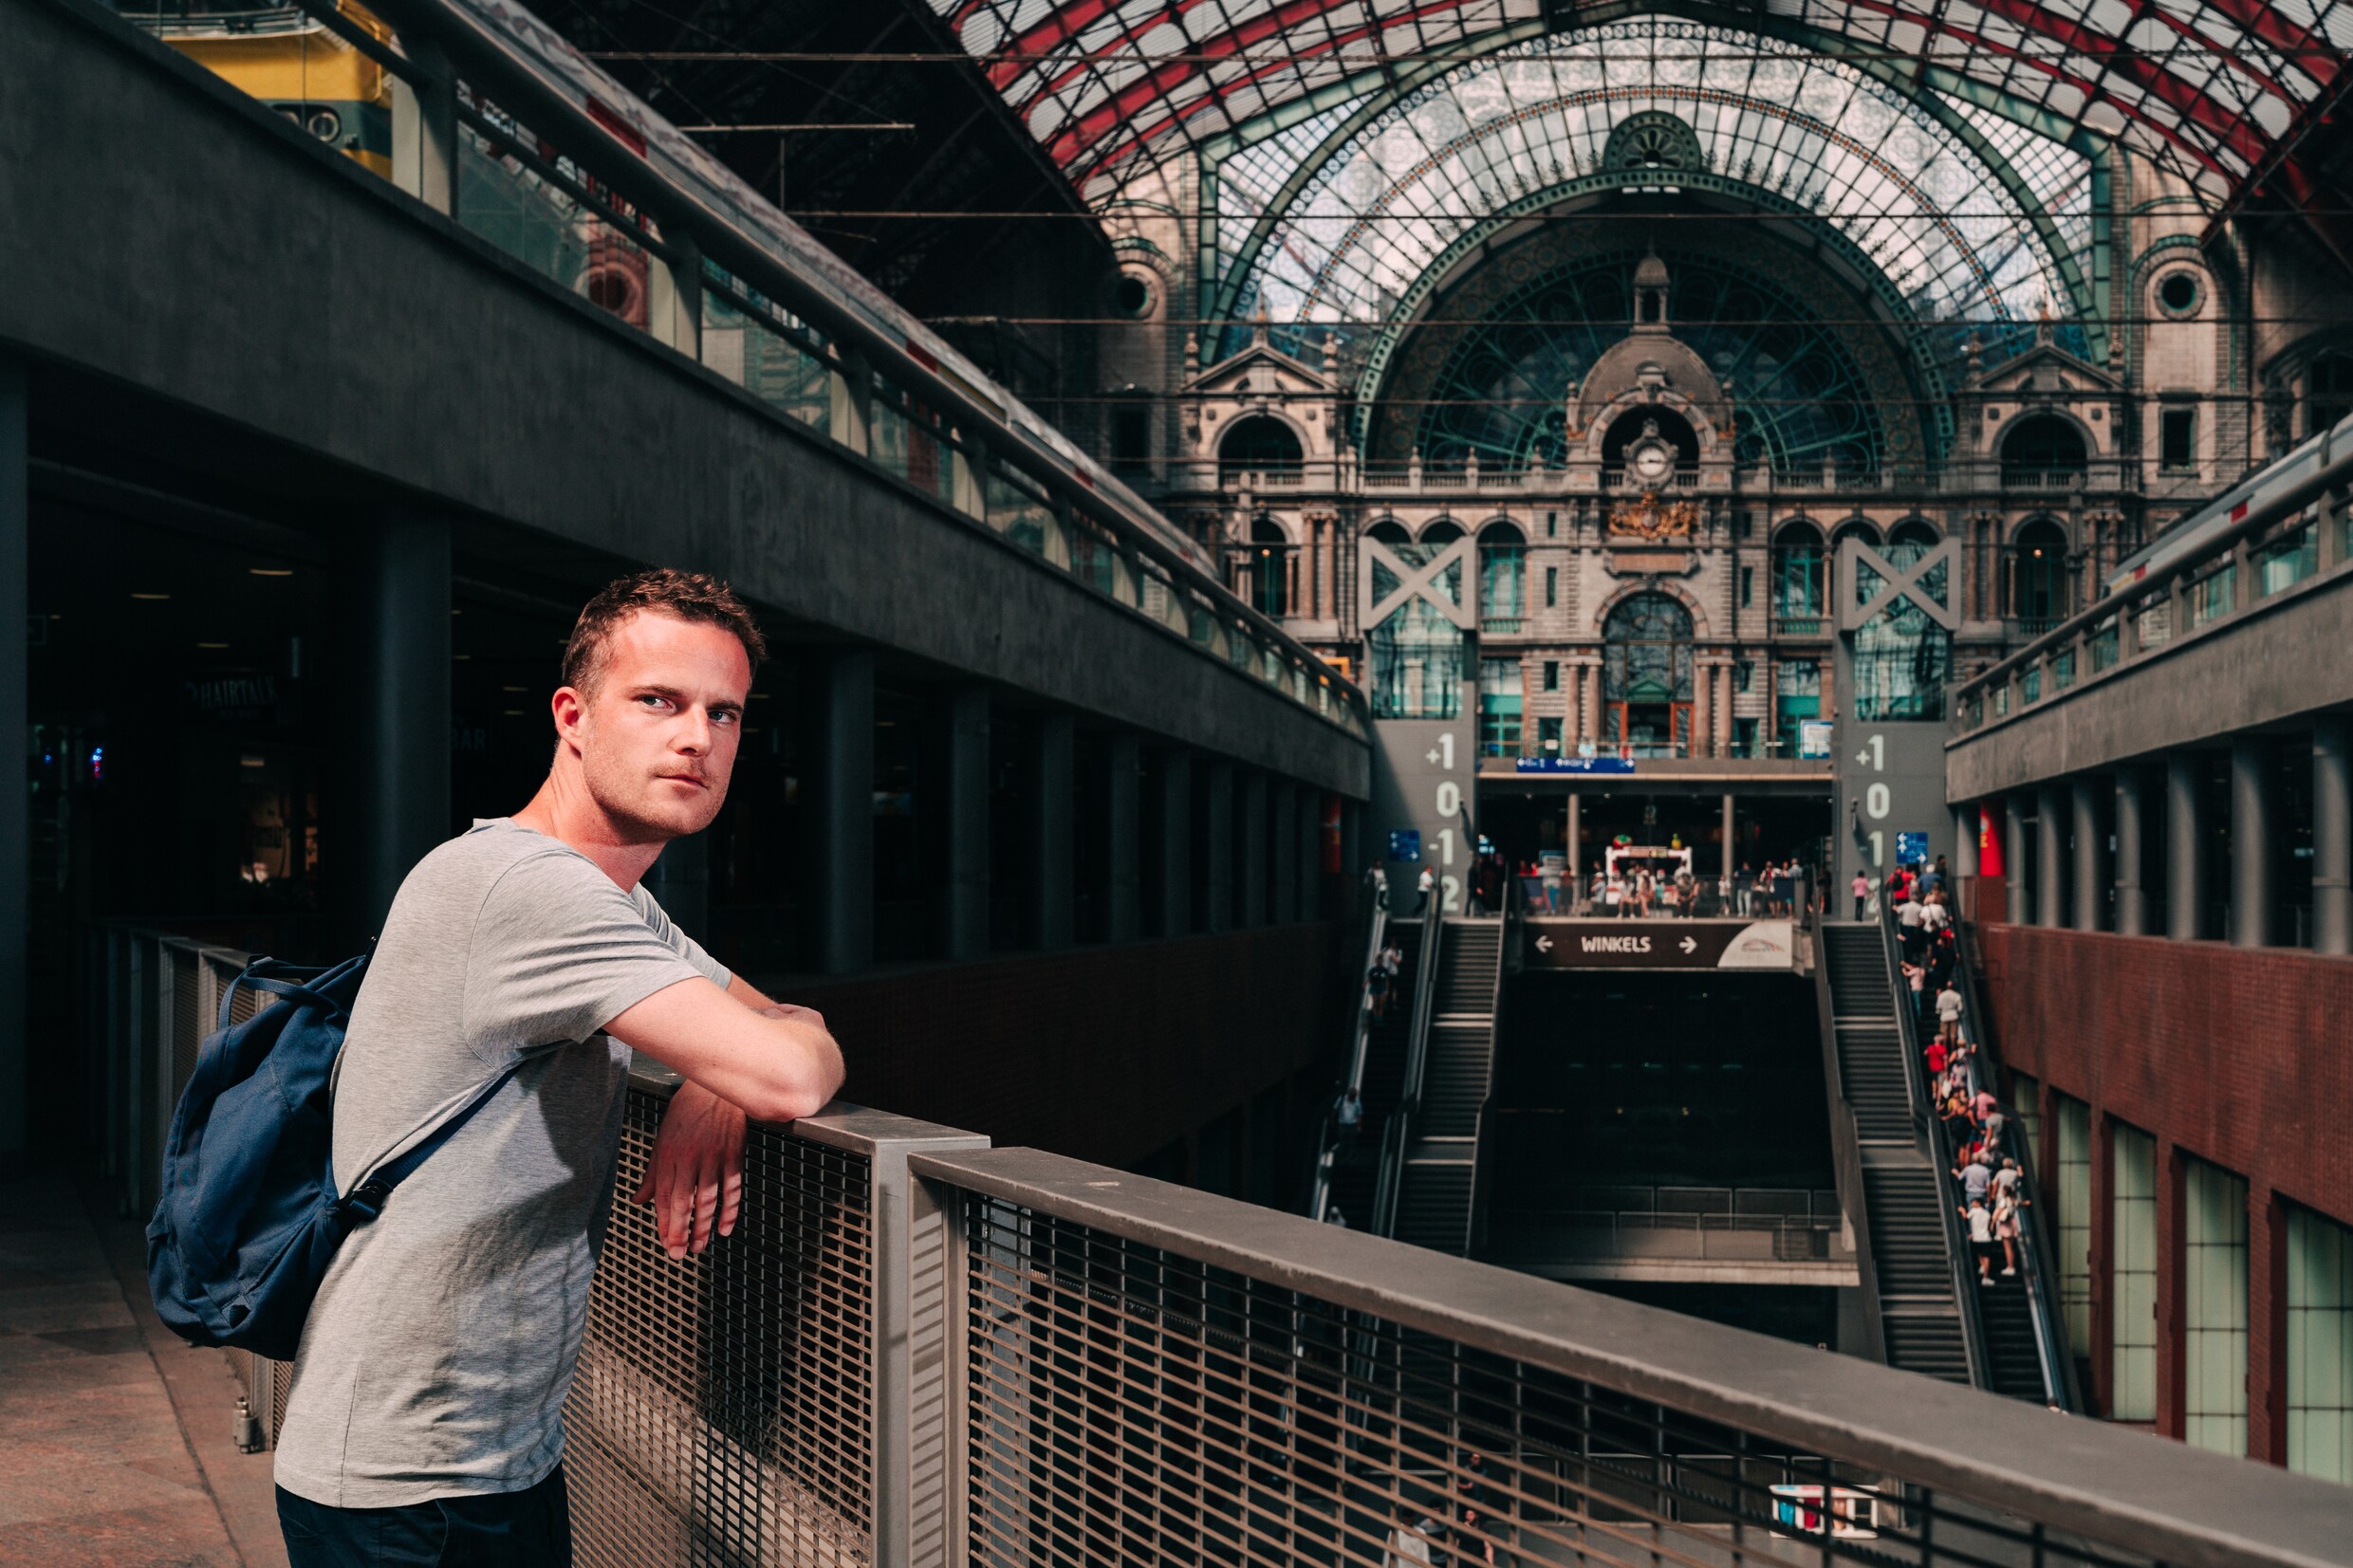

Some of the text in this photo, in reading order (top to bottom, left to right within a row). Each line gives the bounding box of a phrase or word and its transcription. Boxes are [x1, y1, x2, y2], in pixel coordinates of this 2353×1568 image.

[1425, 732, 1454, 770] +1
[1855, 734, 1884, 771] +1
[1436, 781, 1460, 818] 0
[1866, 782, 1890, 820] 0
[1440, 875, 1460, 912] 2
[1581, 935, 1651, 953] WINKELS
